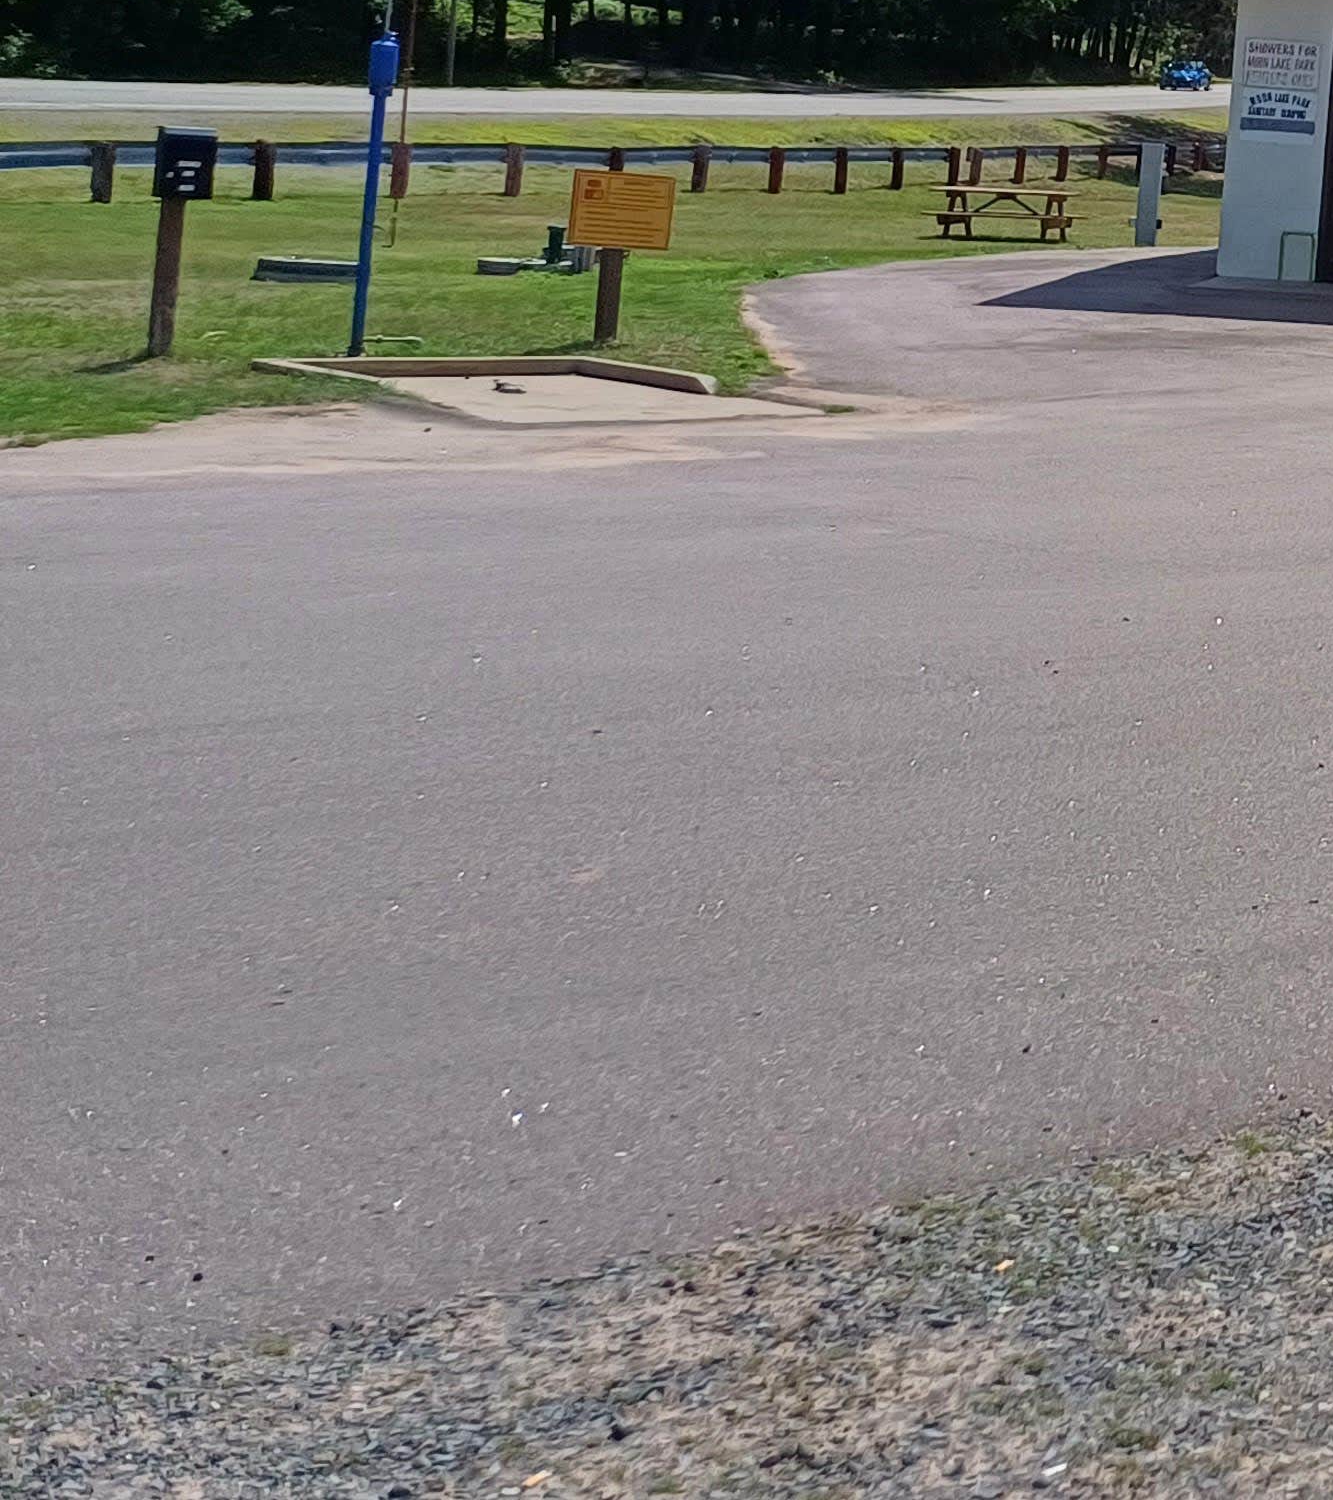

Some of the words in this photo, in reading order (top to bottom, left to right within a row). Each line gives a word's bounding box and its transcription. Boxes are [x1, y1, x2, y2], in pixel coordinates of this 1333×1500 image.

[1248, 42, 1295, 56] SHOWERS
[1299, 44, 1317, 57] FOR
[1271, 58, 1291, 70] LAKE
[1249, 92, 1272, 105] MOON
[1274, 93, 1290, 104] LAKE
[1292, 95, 1311, 108] PARK
